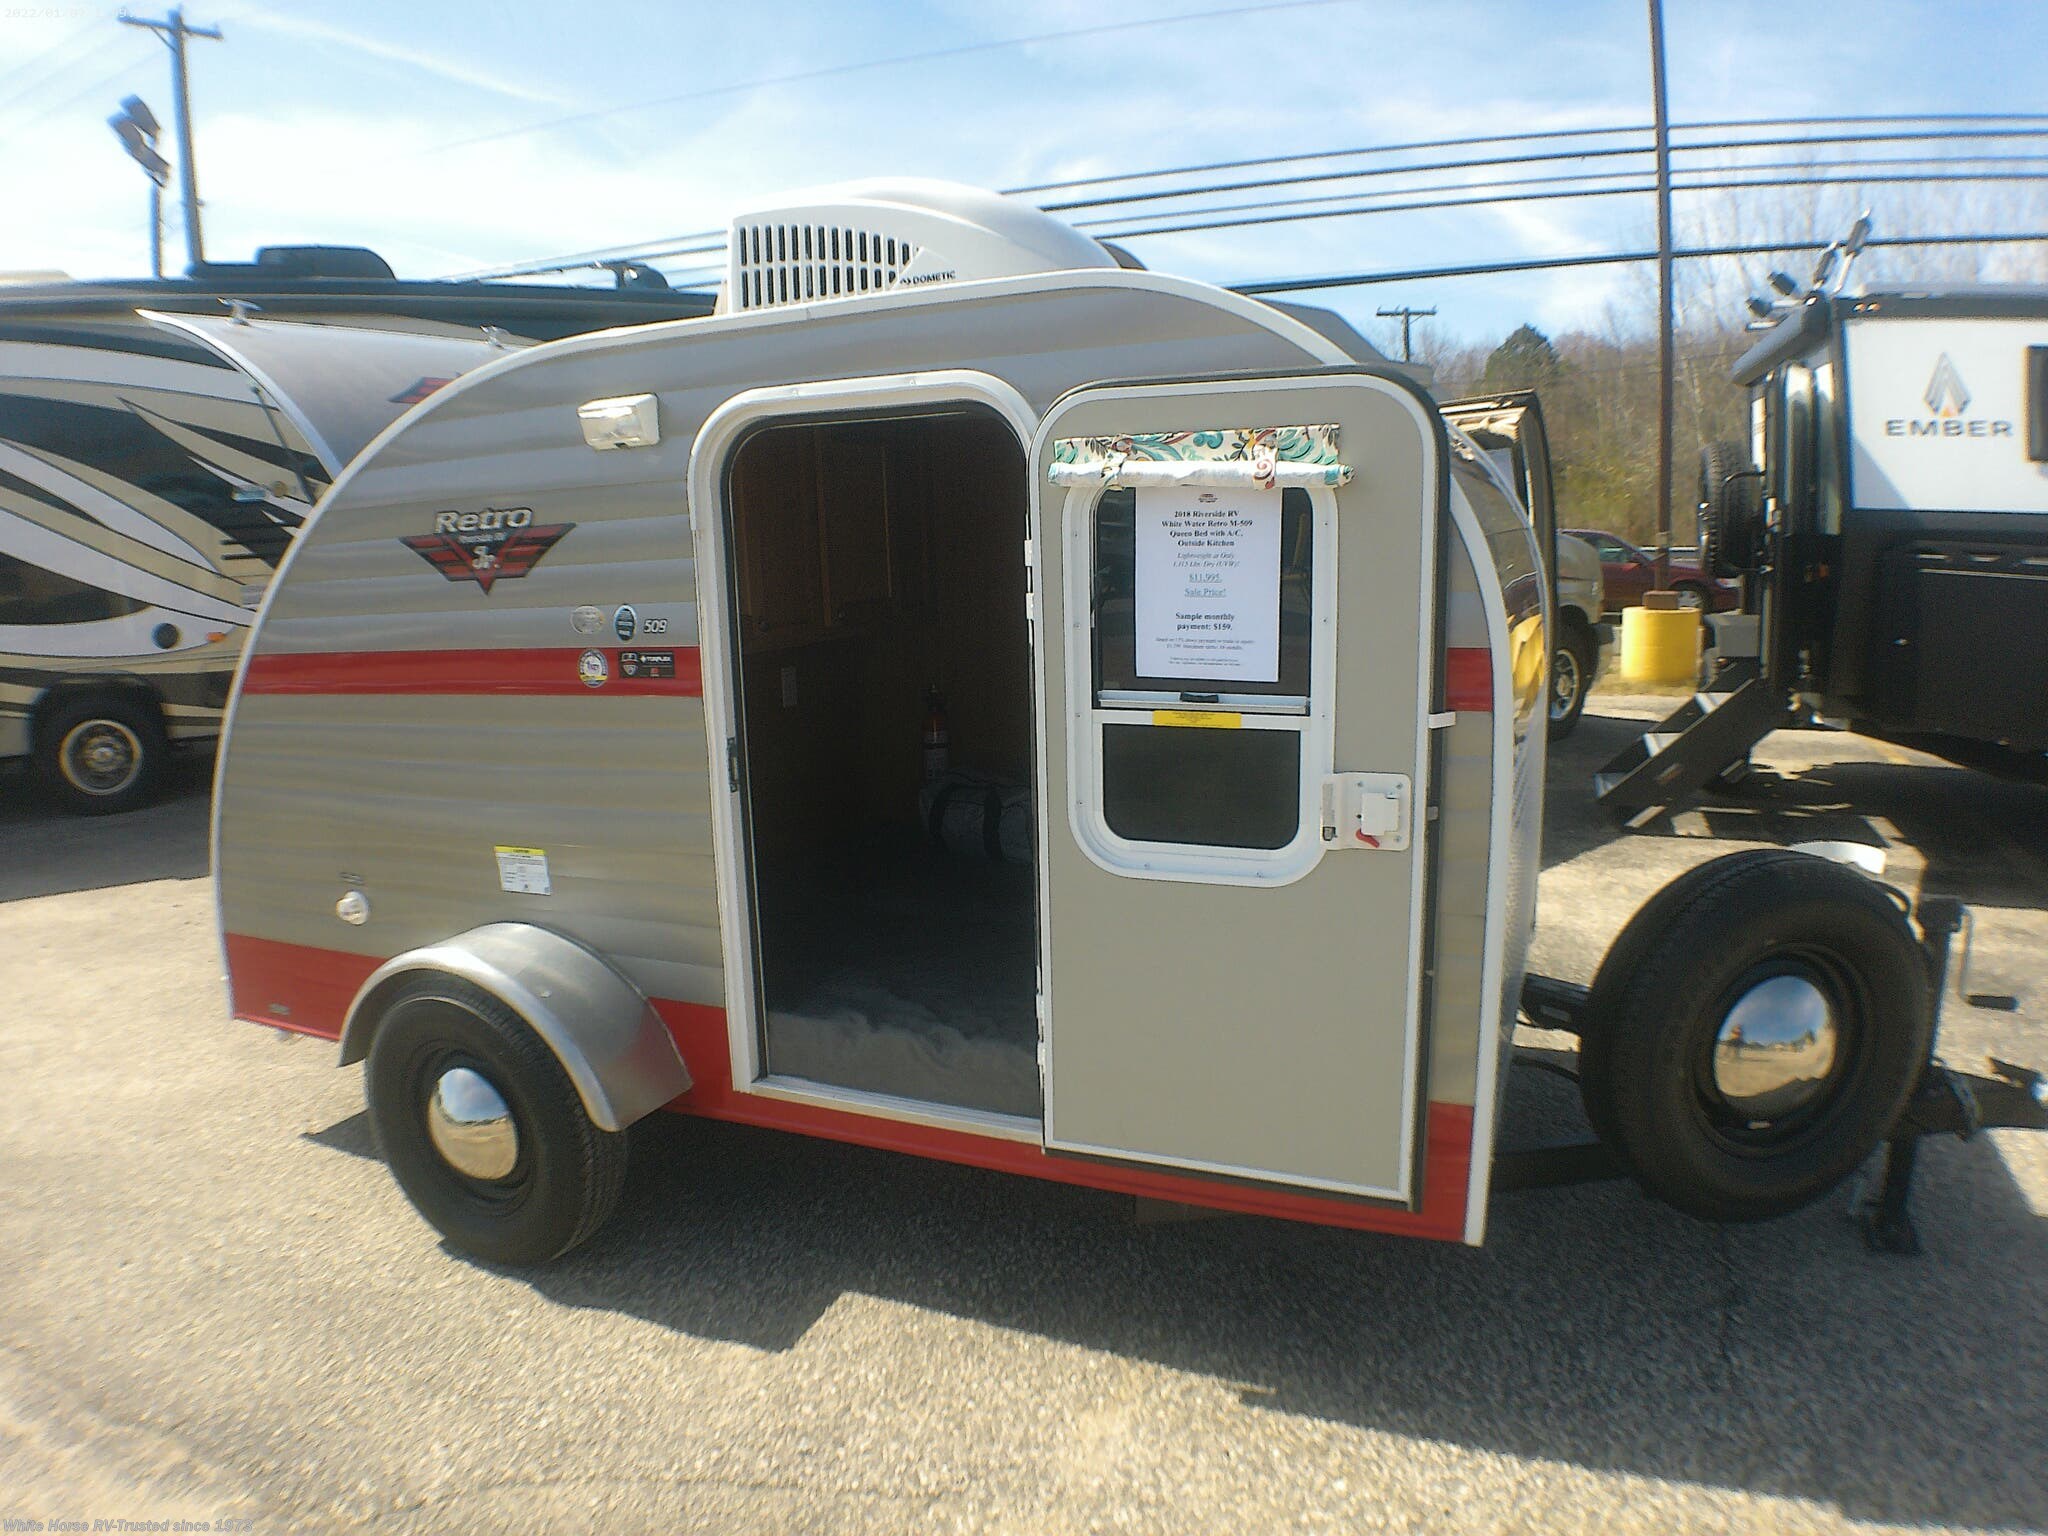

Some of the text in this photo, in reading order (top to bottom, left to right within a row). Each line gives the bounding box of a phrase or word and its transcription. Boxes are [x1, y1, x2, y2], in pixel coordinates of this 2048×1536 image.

[912, 270, 956, 284] DOMETIC
[1885, 419, 2013, 437] EMBER
[1174, 510, 1240, 518] 2018 Riverside RV
[435, 507, 534, 533] Retro
[1161, 520, 1182, 528] White
[1184, 520, 1206, 528] Water
[1169, 530, 1193, 538] Queen
[1184, 588, 1201, 597] Sale
[1175, 612, 1235, 622] Sample monthly
[643, 618, 668, 633] 509
